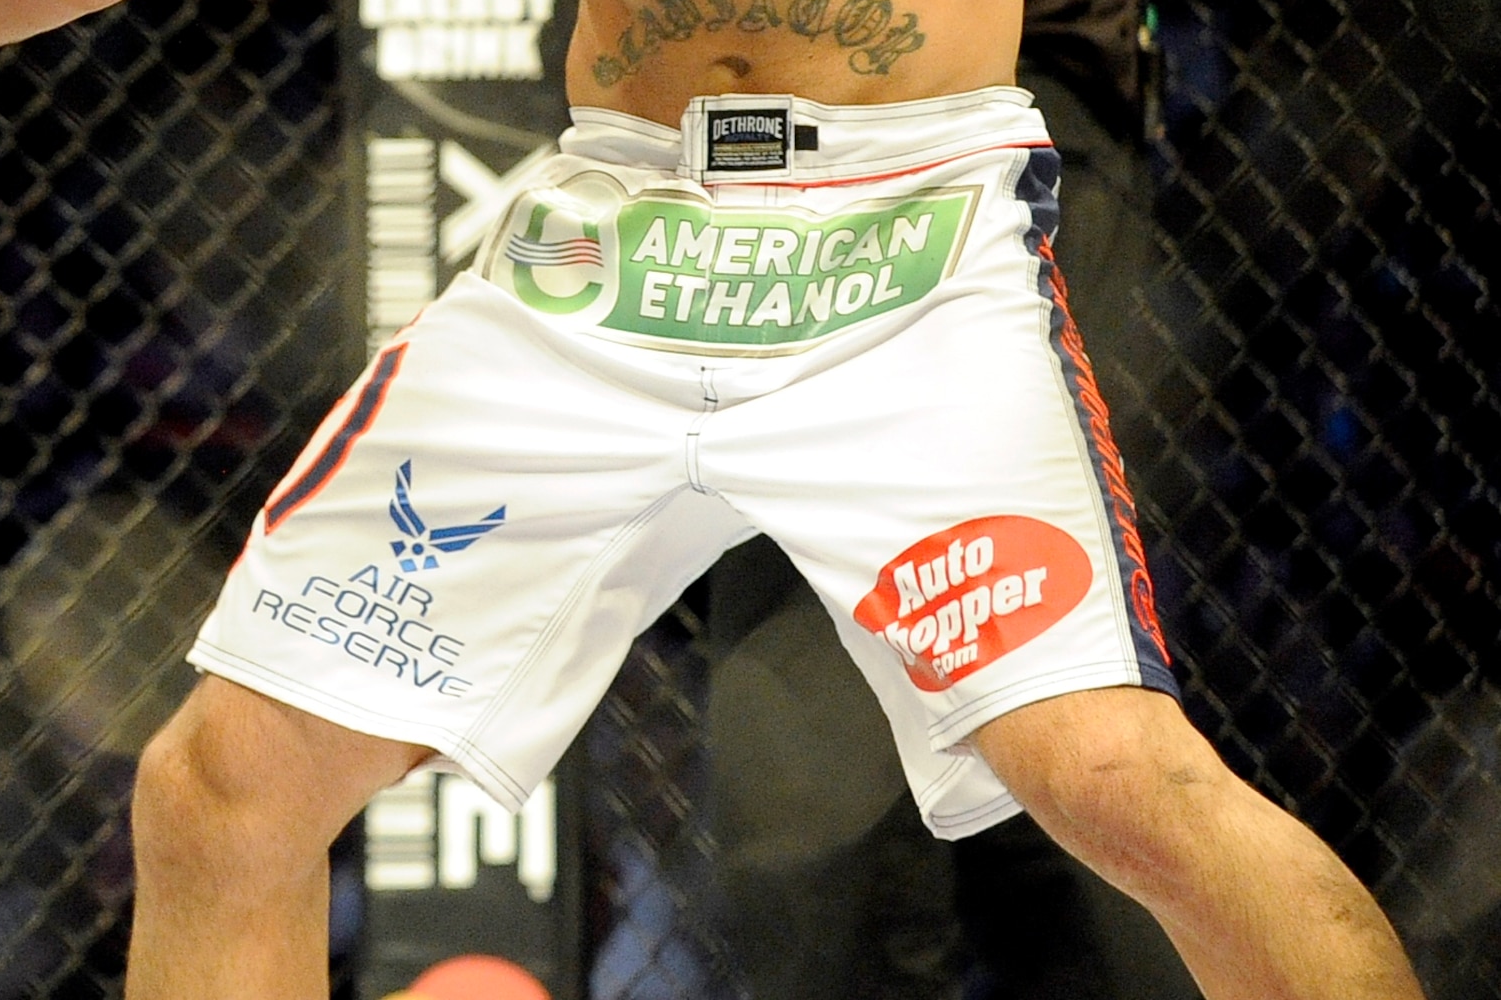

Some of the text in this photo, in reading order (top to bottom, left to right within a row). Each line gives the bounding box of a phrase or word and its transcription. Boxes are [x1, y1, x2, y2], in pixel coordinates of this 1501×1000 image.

[376, 24, 544, 82] DRINK
[712, 115, 784, 141] DETHRONE
[631, 212, 933, 277] AMERICAN
[638, 264, 903, 328] ETHANOL
[348, 564, 434, 617] AIR
[893, 536, 994, 618] Auto
[252, 589, 474, 698] RESERVE
[301, 575, 466, 667] FORCE
[875, 566, 1048, 666] hopper
